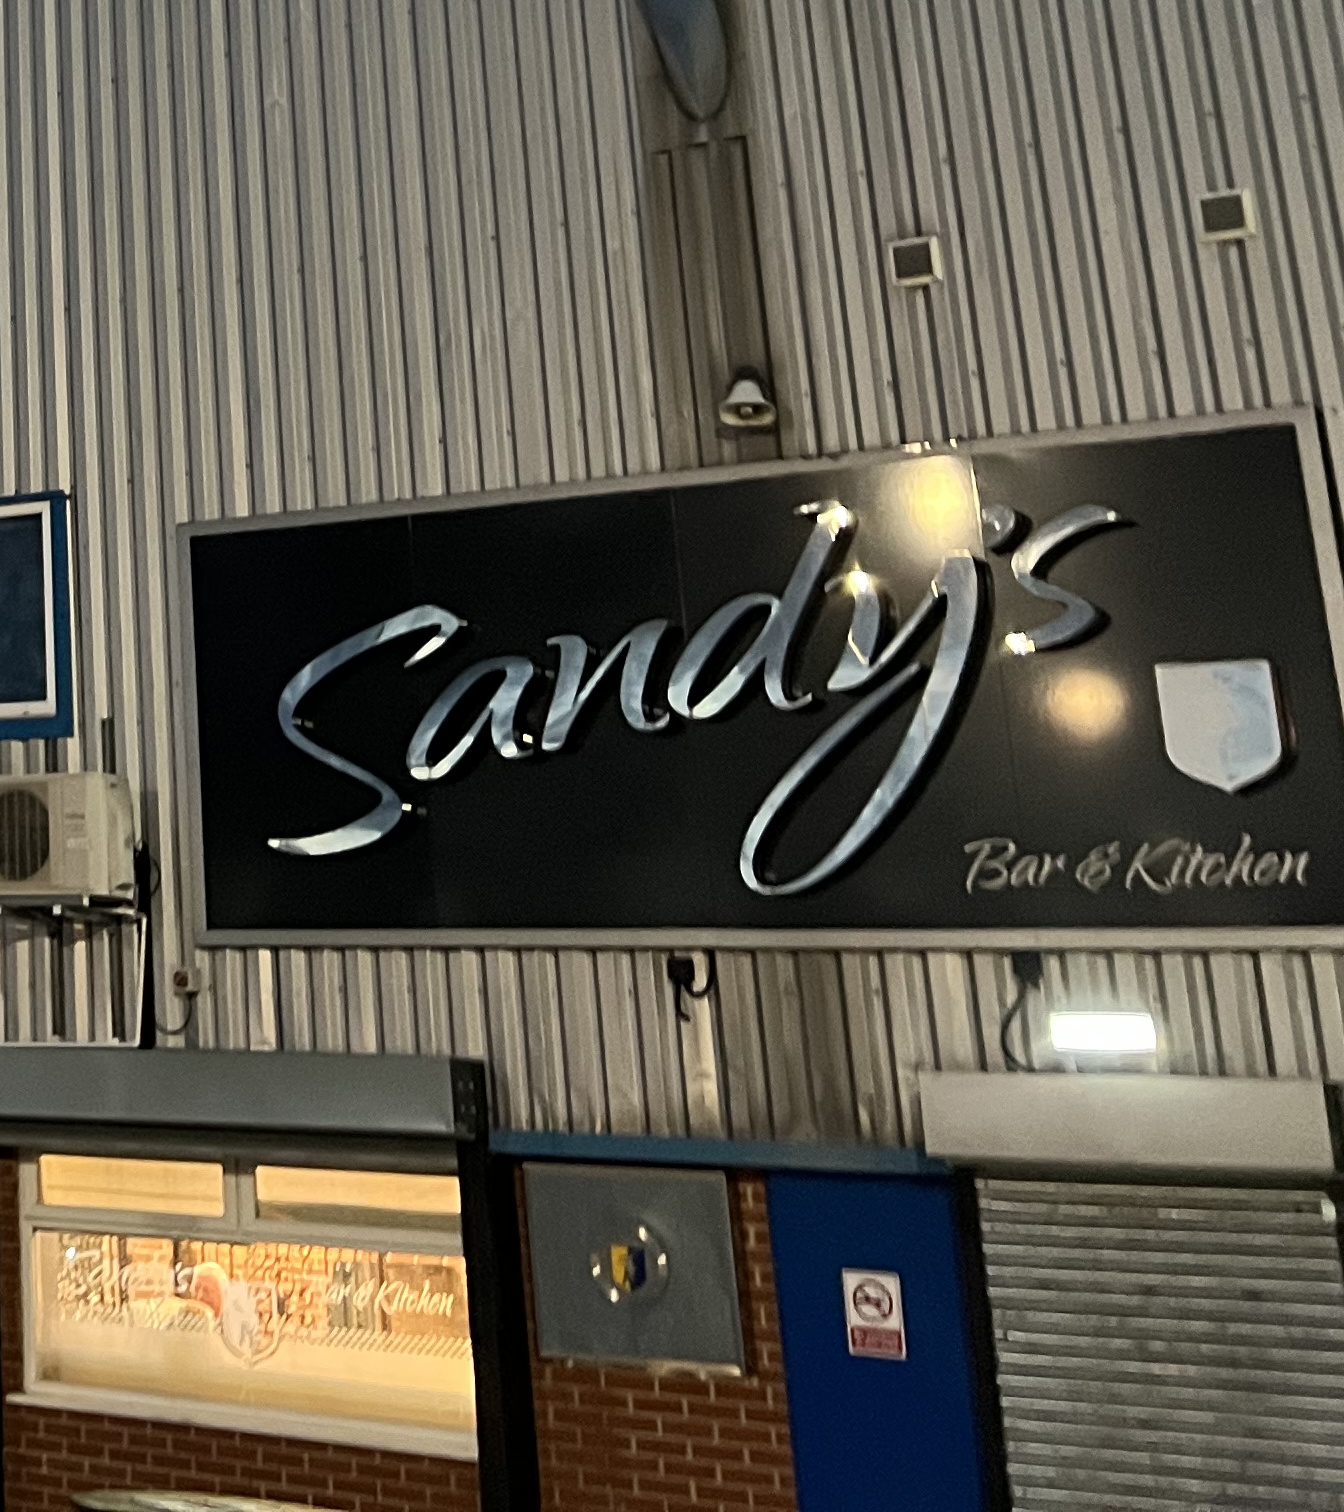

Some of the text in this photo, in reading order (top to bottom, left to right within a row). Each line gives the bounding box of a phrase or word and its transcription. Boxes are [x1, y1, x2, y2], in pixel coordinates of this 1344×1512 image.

[266, 500, 1127, 896] Sandy's
[963, 832, 1309, 895] Bar & Kitchen
[374, 1279, 454, 1318] Kitchen
